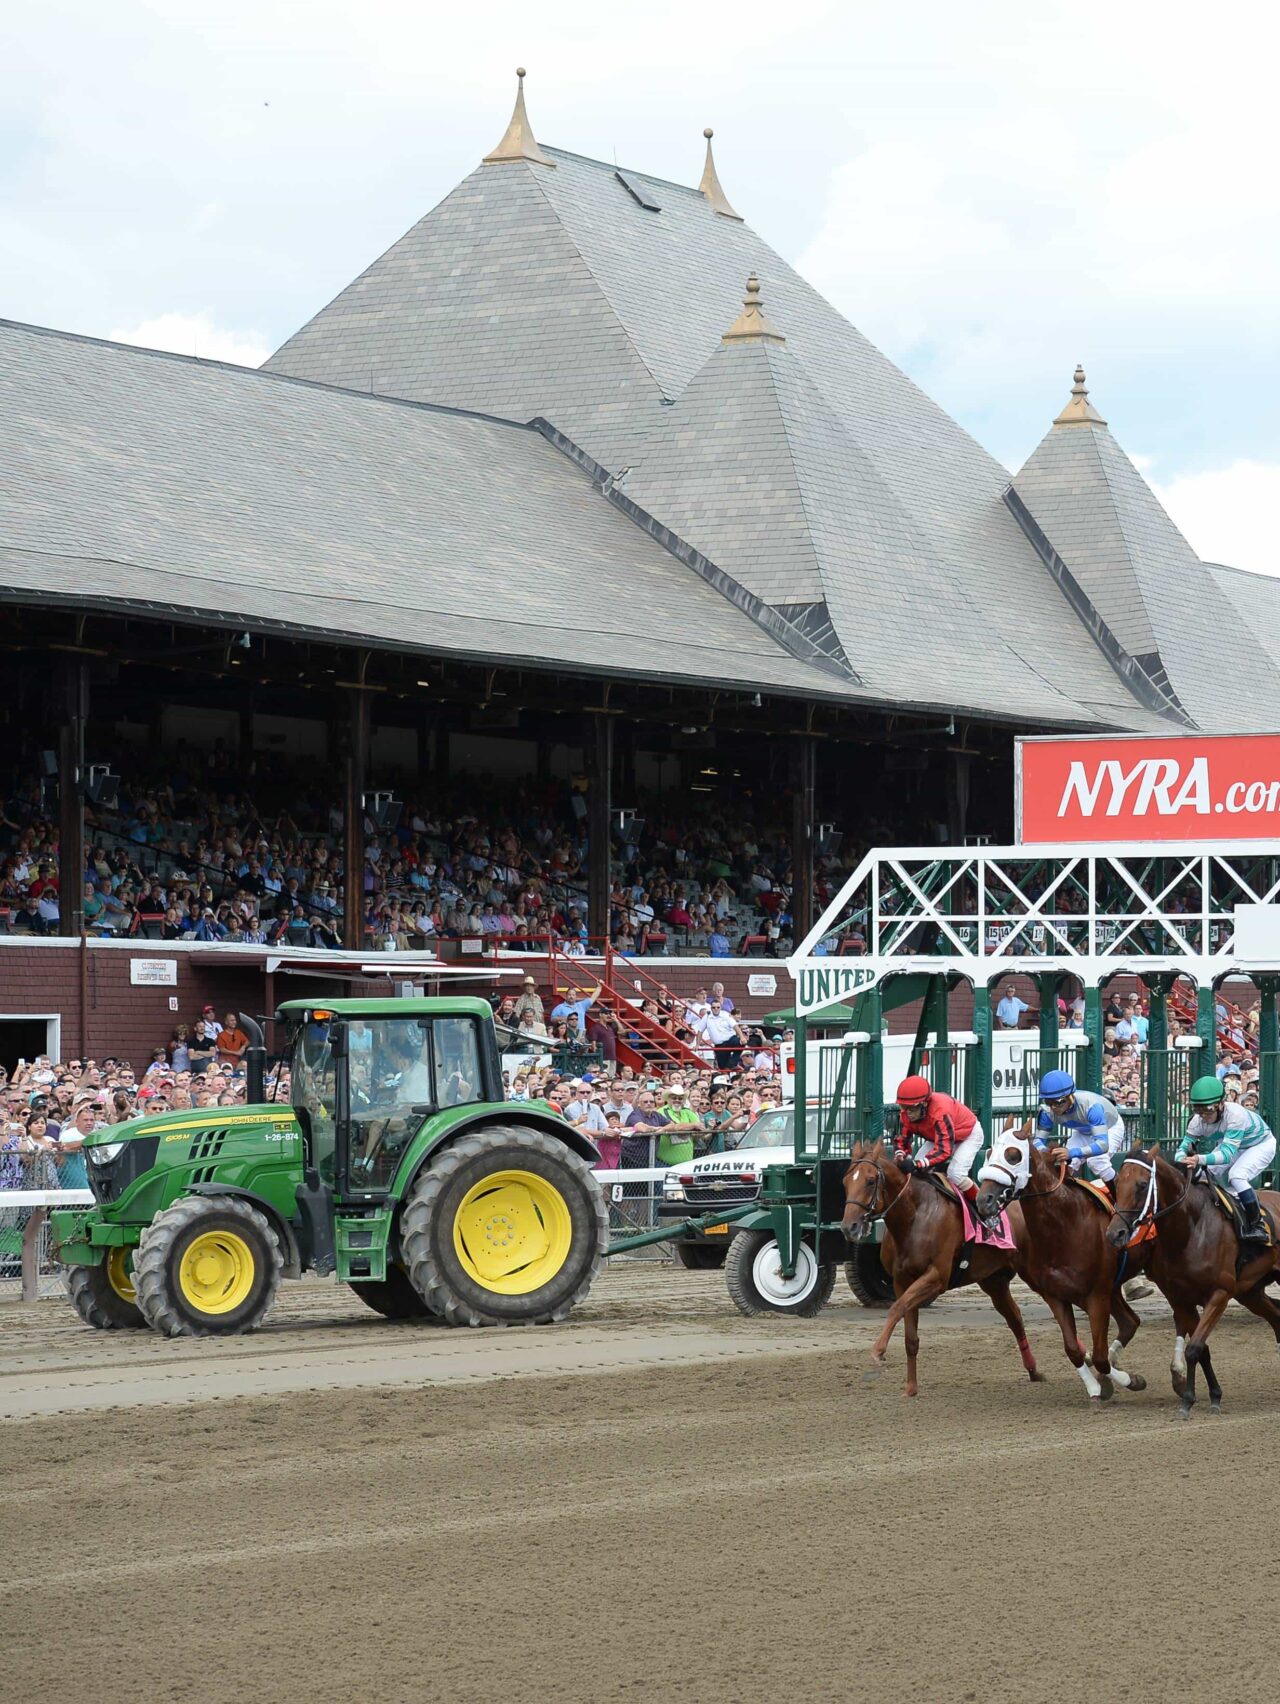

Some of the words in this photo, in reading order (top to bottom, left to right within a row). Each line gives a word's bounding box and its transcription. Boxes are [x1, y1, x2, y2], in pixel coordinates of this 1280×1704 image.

[960, 928, 969, 938] 16
[990, 928, 998, 938] 15
[799, 968, 876, 1007] UNITED
[230, 1117, 248, 1125] JOHN
[265, 1133, 299, 1141] 1-26-874
[693, 1162, 756, 1173] MOHAWK
